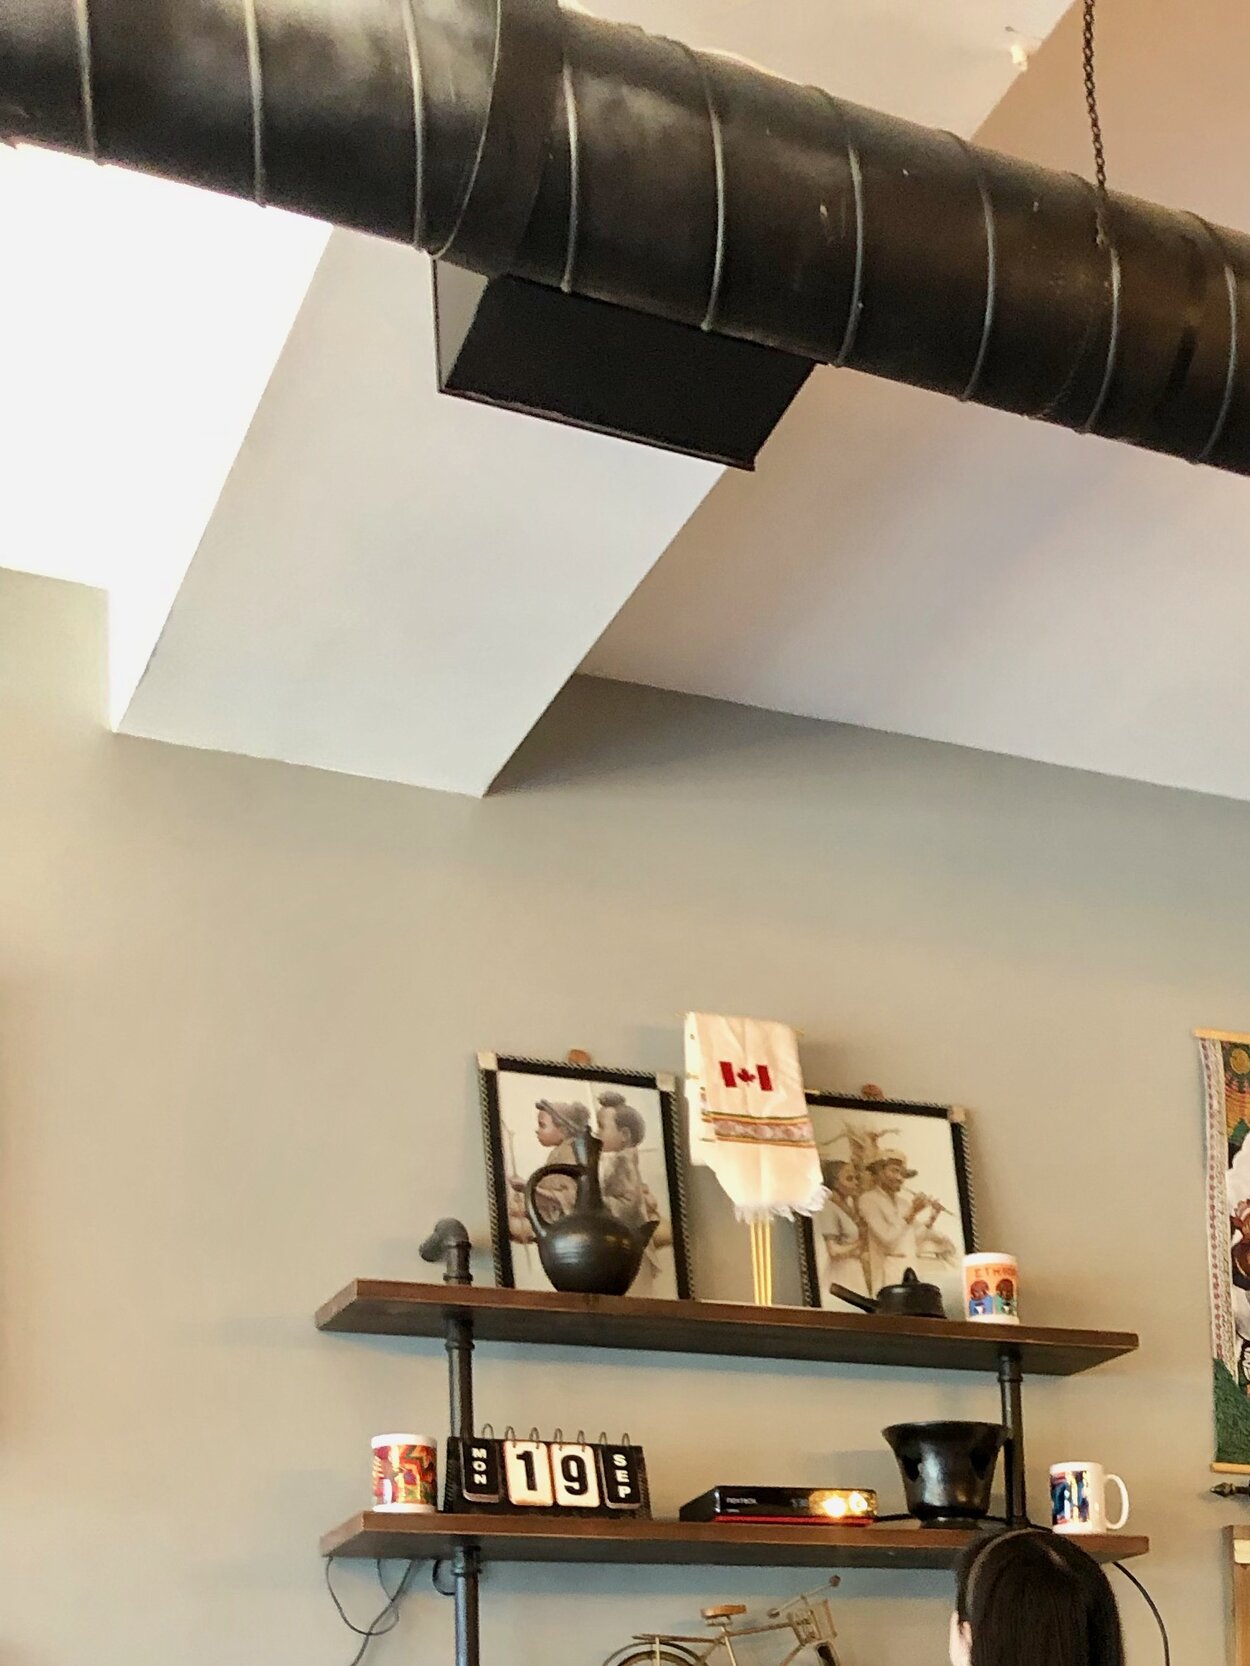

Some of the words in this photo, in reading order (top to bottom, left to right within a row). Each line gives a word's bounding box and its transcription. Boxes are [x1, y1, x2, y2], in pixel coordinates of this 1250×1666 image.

[472, 1447, 488, 1485] MON
[516, 1450, 588, 1495] 19
[613, 1454, 631, 1498] SEP
